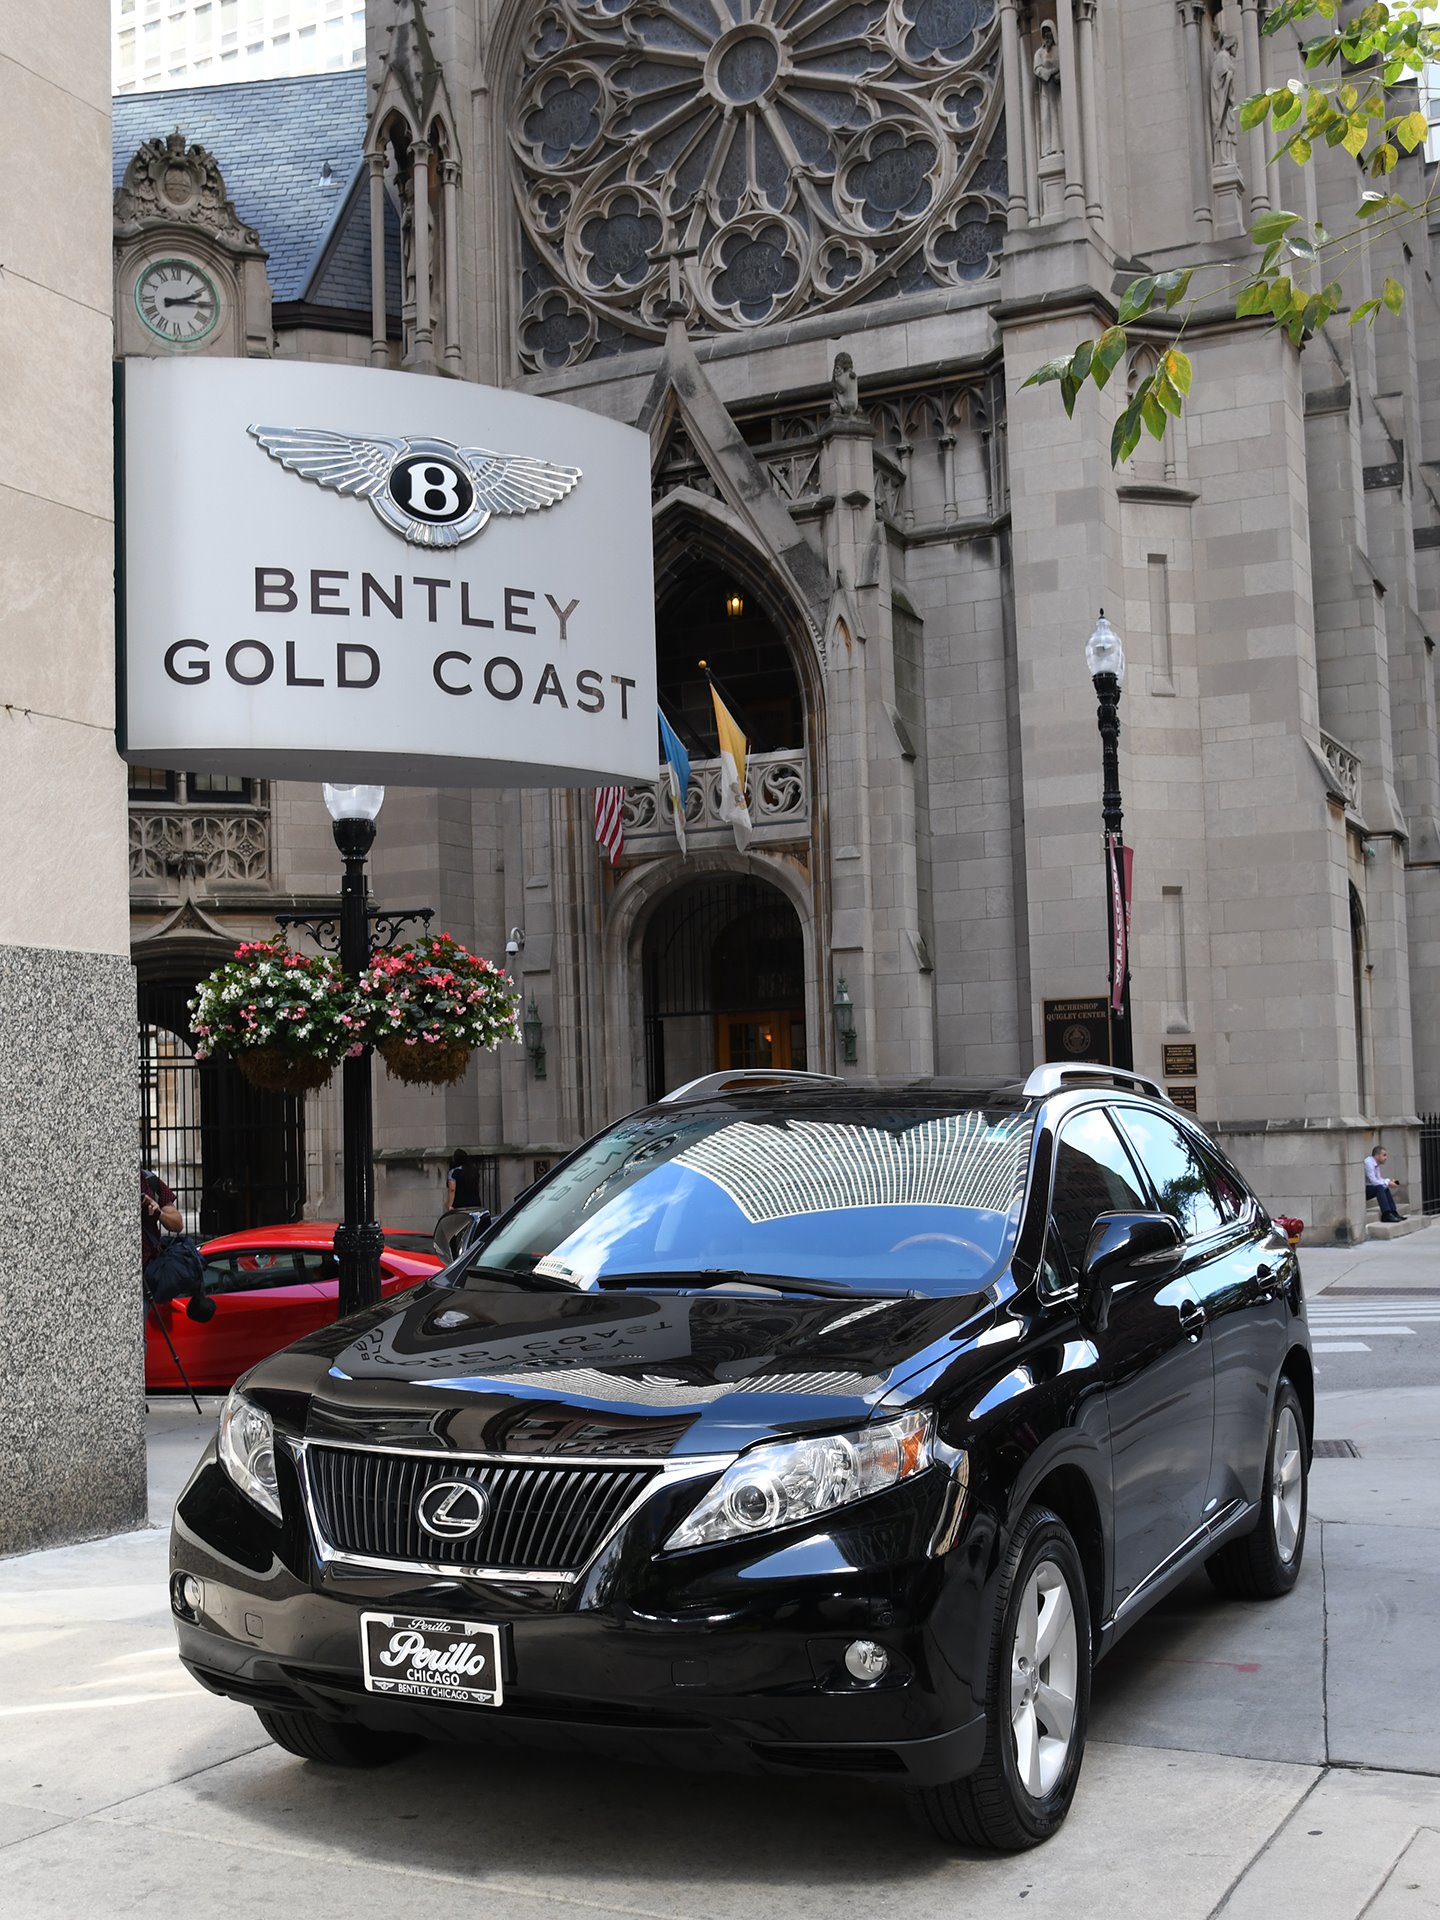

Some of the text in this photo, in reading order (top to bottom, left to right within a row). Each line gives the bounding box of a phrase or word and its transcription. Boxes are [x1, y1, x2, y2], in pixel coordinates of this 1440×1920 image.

[408, 462, 461, 516] B
[254, 566, 580, 641] BENTLEY
[163, 638, 637, 720] GOLD COAST
[1053, 1003, 1098, 1011] ARCHBISHOP
[1046, 1011, 1106, 1022] QUIGLEY CENTER
[407, 1618, 451, 1632] Perillo
[380, 1631, 486, 1676] Perillo
[406, 1668, 460, 1686] CHICAGO
[398, 1683, 469, 1700] BENTLEY CHICAGO
